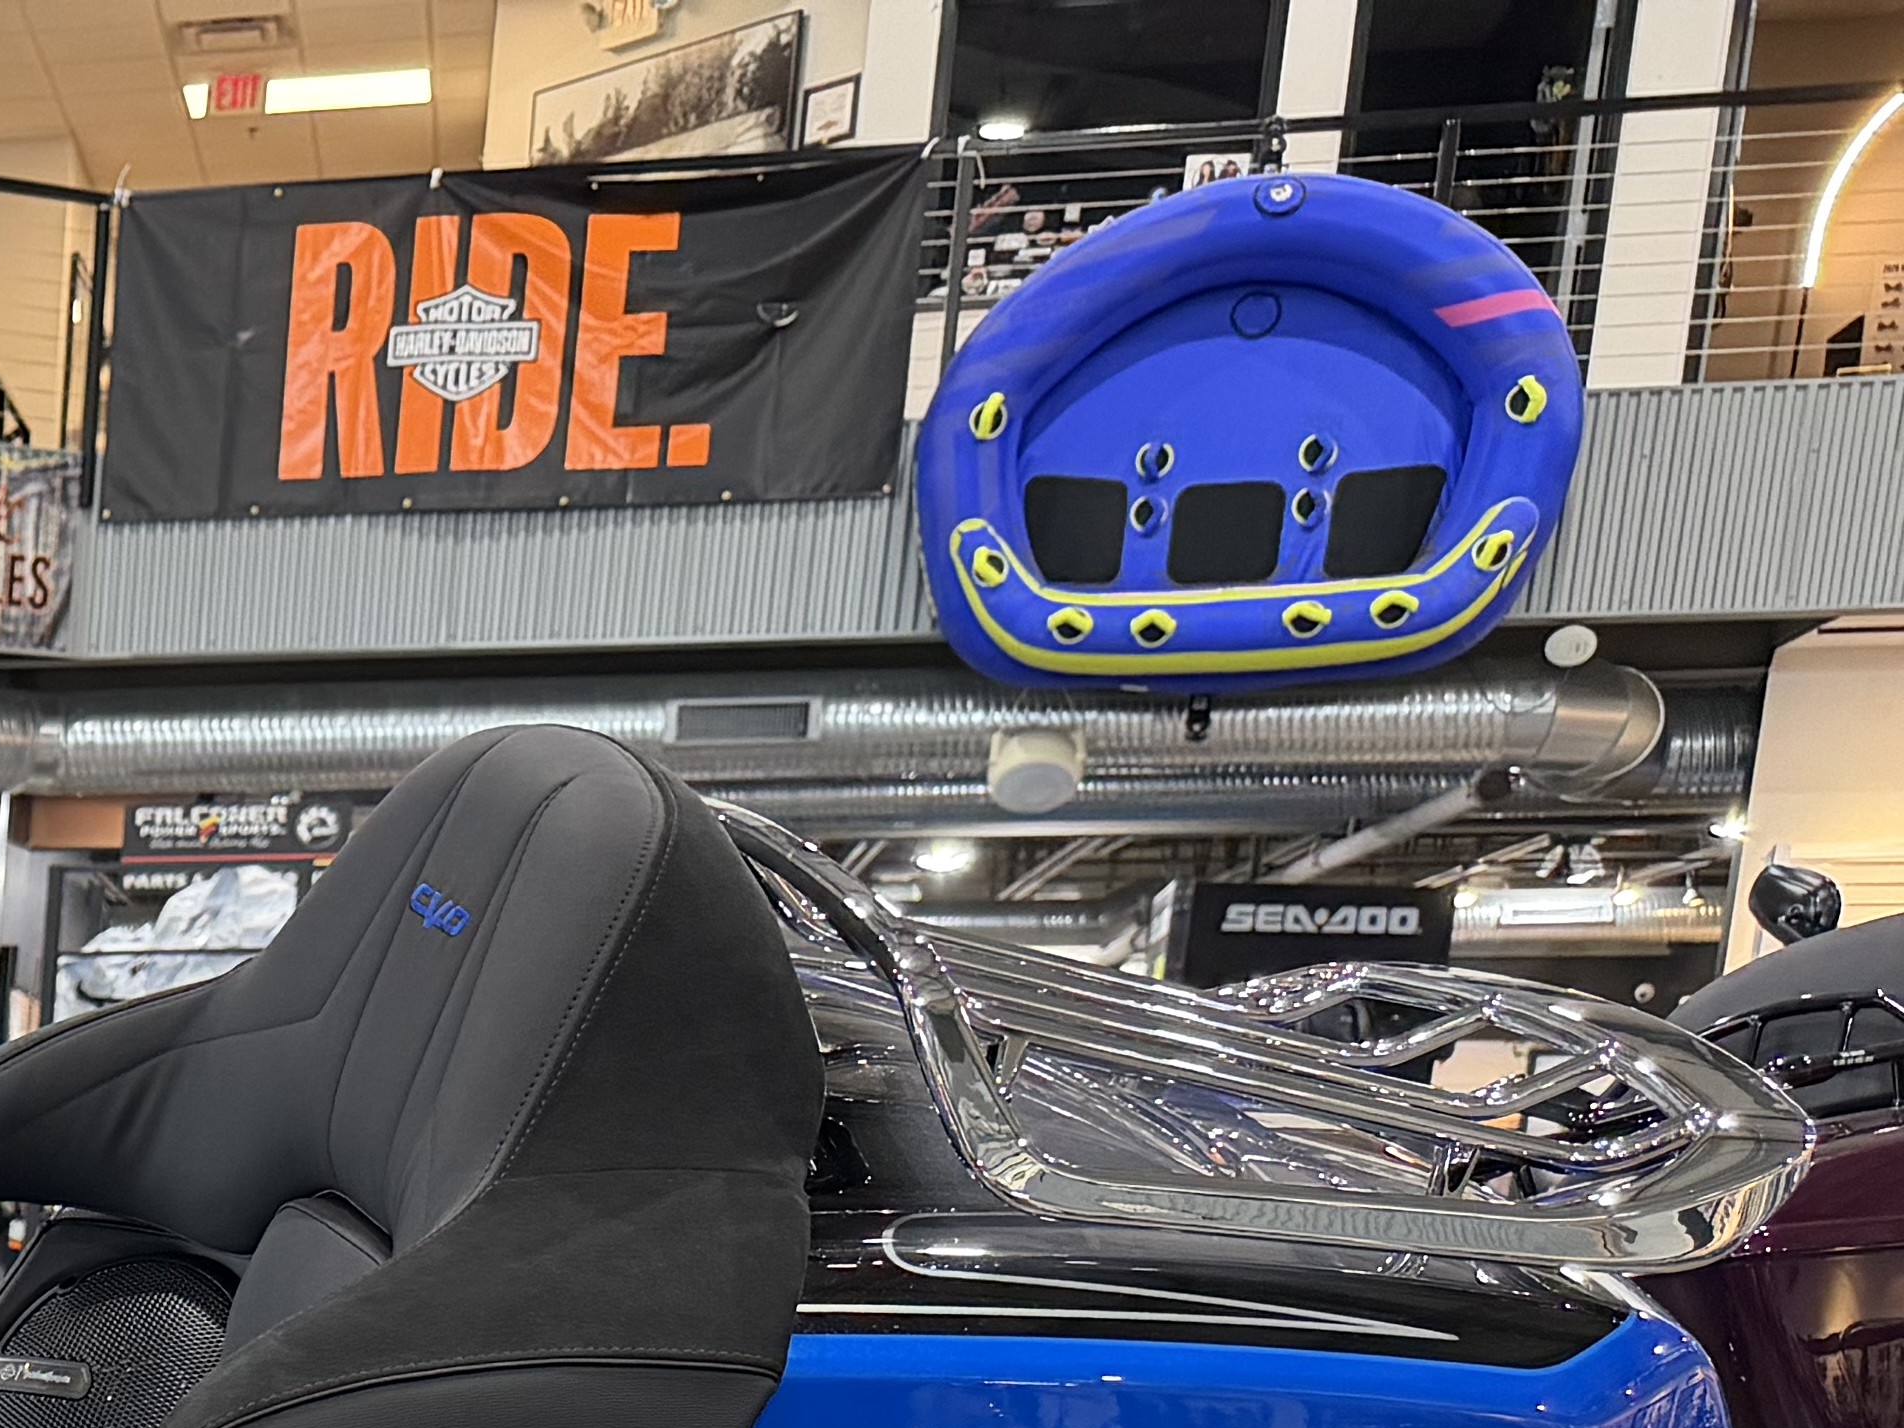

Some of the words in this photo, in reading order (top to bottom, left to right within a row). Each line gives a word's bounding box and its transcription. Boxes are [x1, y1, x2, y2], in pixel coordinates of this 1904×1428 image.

[429, 294, 501, 322] MOTOR
[278, 212, 711, 480] RIDE.
[395, 329, 531, 357] HARLEY-DAVIDSON
[424, 361, 497, 392] CYCLES
[123, 873, 188, 891] PARTS
[411, 883, 472, 937] CVO
